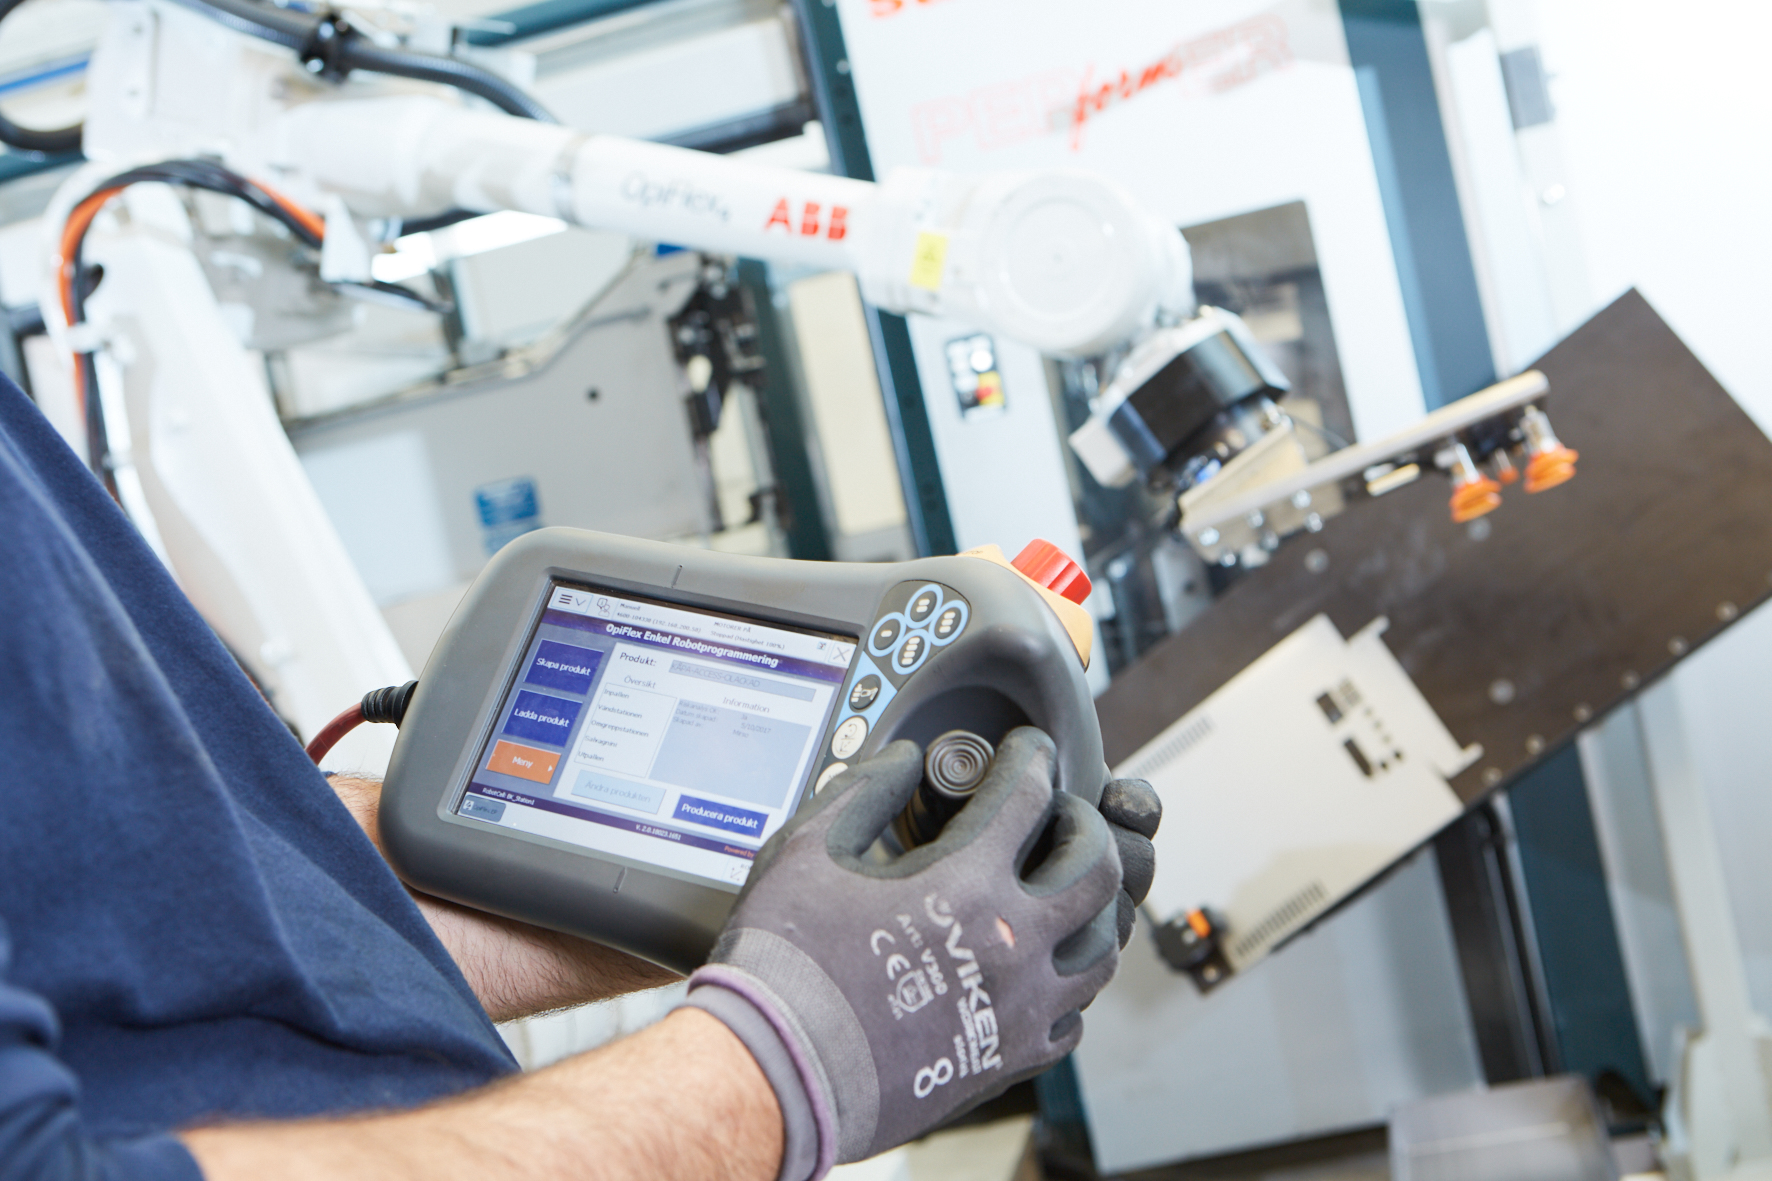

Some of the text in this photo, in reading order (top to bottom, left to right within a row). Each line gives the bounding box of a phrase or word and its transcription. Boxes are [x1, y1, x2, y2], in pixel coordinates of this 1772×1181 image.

[764, 195, 850, 242] ABB
[606, 623, 779, 668] OpiFlex Enkel Robotprogrammering
[536, 657, 591, 676] Skapa produkt
[620, 652, 657, 667] Produkt:
[624, 675, 656, 689] Översikt
[722, 697, 770, 713] Information
[514, 708, 570, 728] Ladda produkt
[512, 756, 534, 769] Meny
[585, 780, 652, 804] Ändra produkten
[681, 802, 759, 829] Producera produkt
[870, 929, 912, 981] CE
[945, 921, 1003, 1070] VIKEN
[913, 1057, 954, 1098] 8
